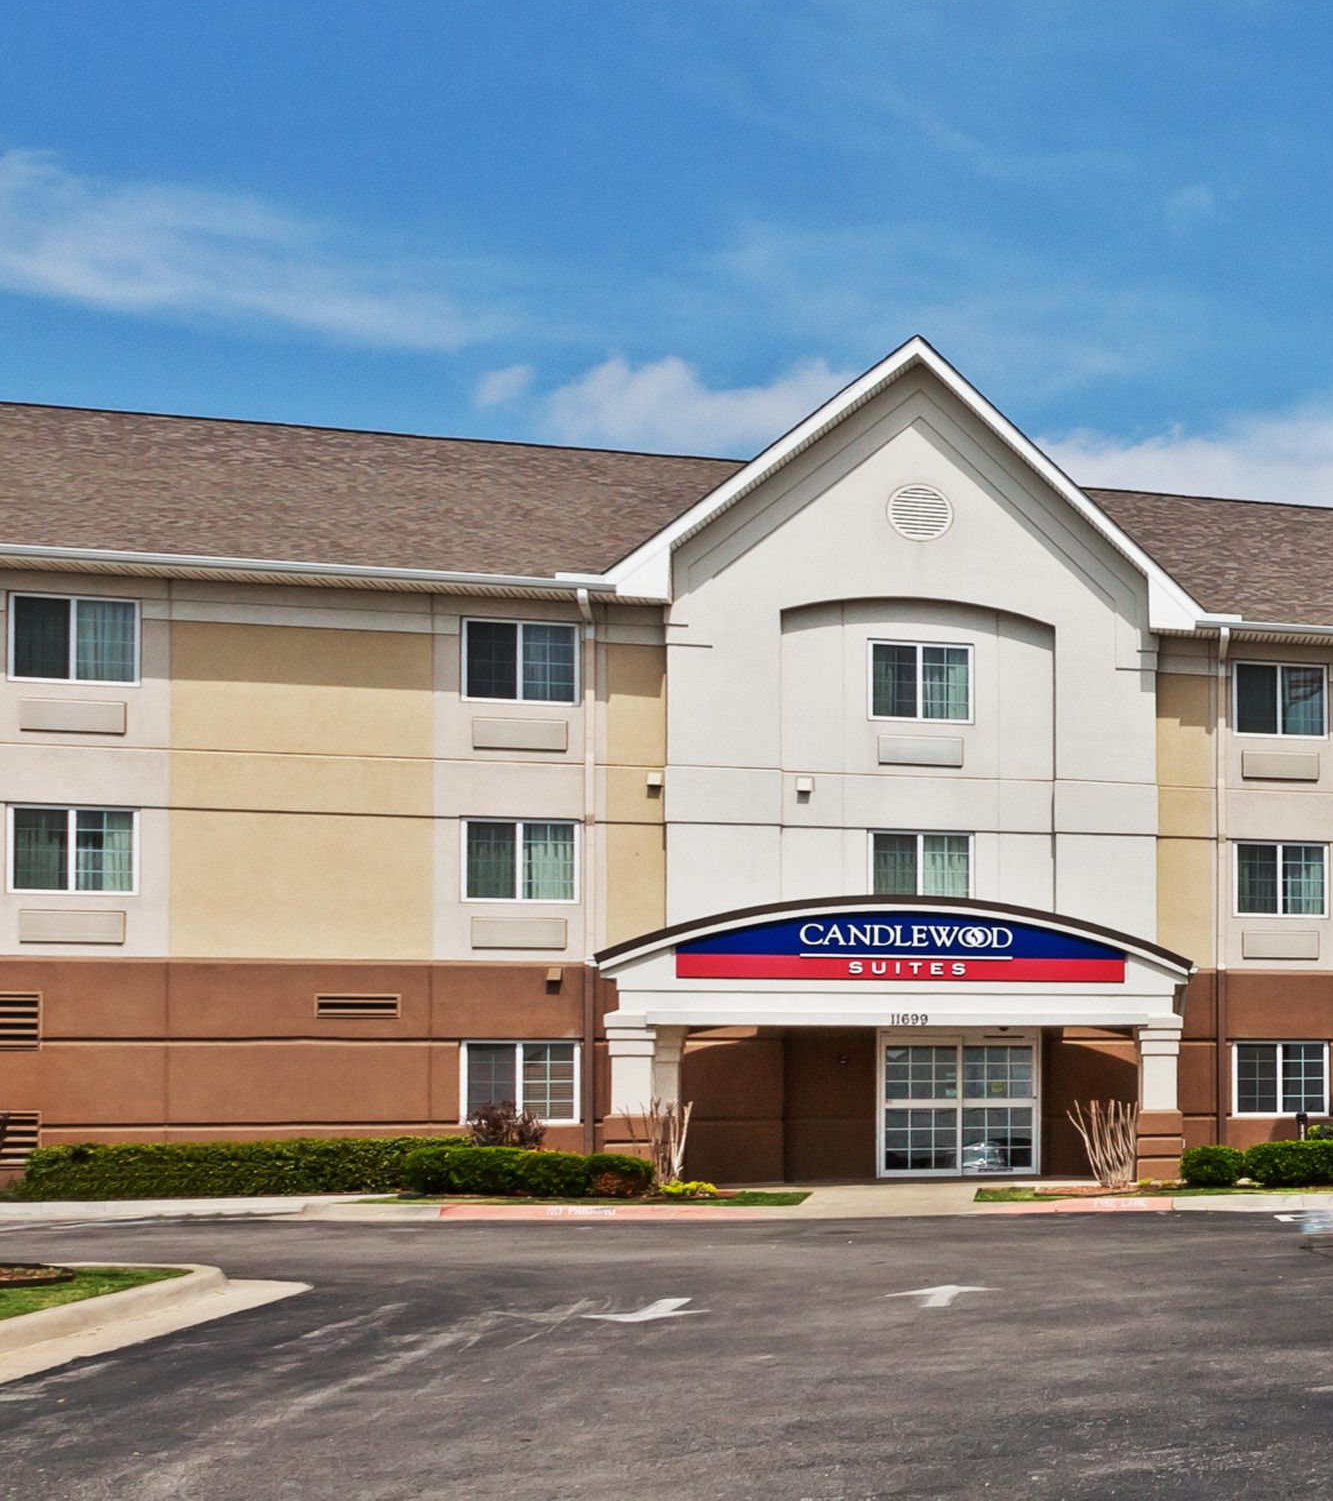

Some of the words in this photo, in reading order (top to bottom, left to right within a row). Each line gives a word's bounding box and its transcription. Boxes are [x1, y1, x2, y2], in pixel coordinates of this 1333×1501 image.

[800, 923, 1013, 948] CANDLEWOOD
[849, 961, 967, 975] SUITES
[890, 1013, 929, 1025] 11699
